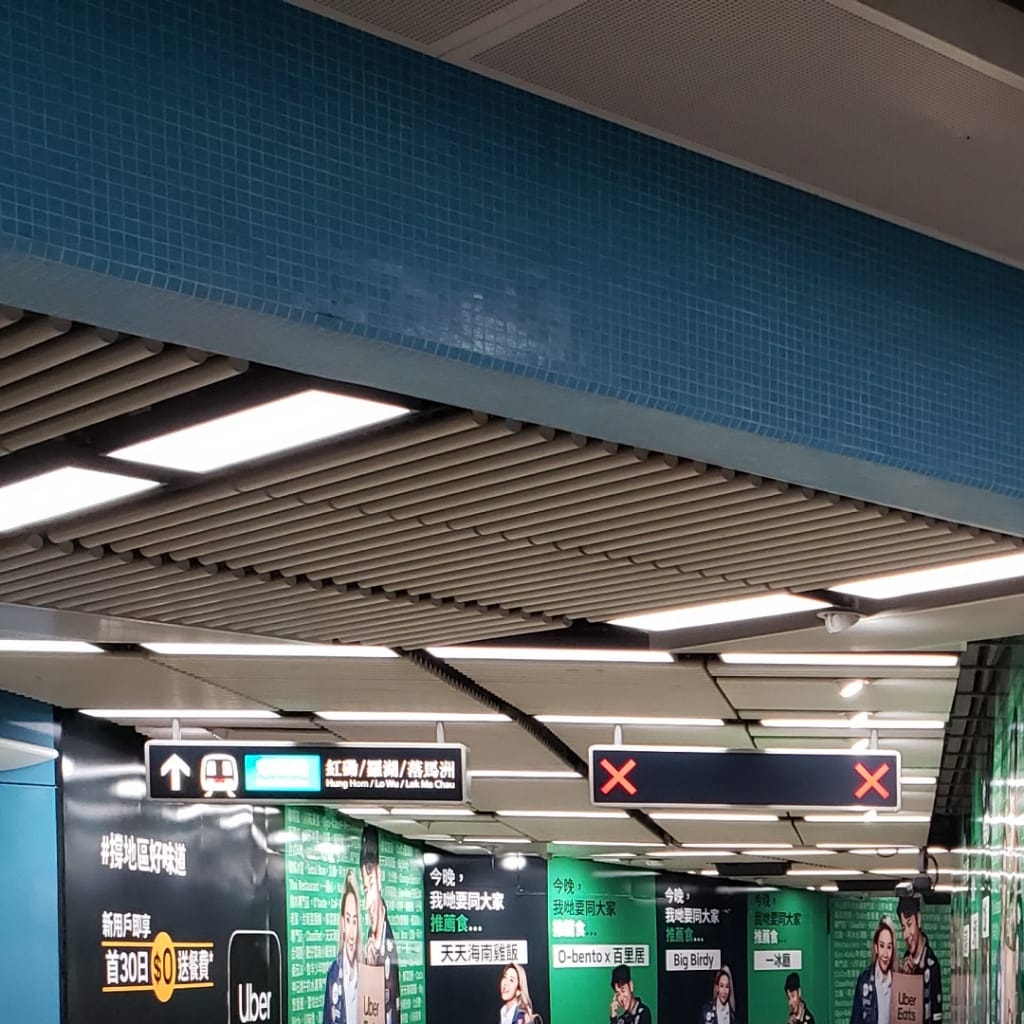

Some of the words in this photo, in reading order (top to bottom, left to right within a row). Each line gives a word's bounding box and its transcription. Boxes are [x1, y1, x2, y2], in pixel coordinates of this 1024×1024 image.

[325, 779, 348, 790] Hung
[349, 780, 369, 789] Hom
[375, 779, 385, 789] Lo
[435, 780, 456, 789] Chau
[429, 891, 505, 911] 我哋要同大家
[553, 900, 616, 917] 我哋要同大家
[441, 943, 519, 962] 天天海南雞飯
[558, 949, 602, 964] O-bento
[613, 948, 645, 964] 百里居
[674, 953, 689, 969] Big
[691, 953, 714, 969] Birdy
[238, 983, 272, 1023] Uber
[363, 994, 379, 1017] Uber
[898, 992, 917, 1006] Uber
[897, 1007, 917, 1021] Eats
